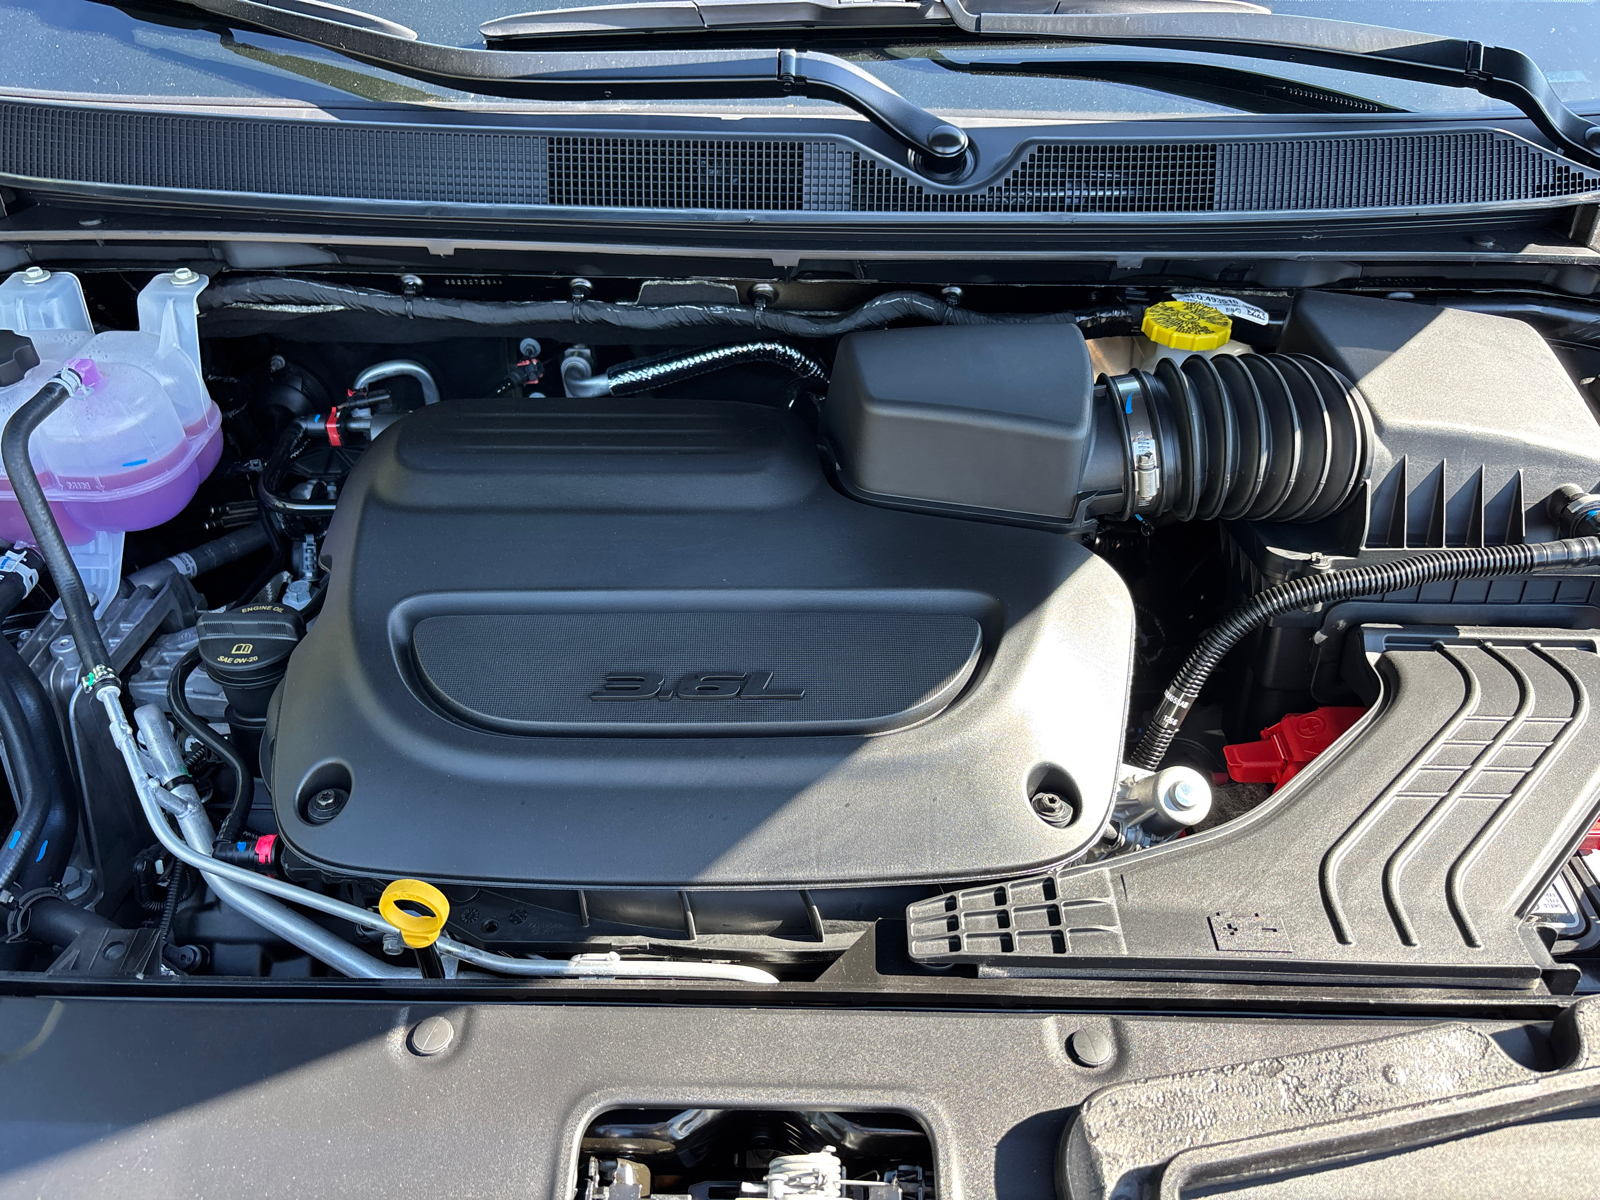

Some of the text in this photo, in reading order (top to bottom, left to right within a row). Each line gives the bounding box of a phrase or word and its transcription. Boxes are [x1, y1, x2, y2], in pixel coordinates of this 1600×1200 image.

[241, 605, 284, 614] ENGINE OIL
[217, 655, 258, 664] SAE 0W-20
[590, 671, 806, 701] 3.6L
